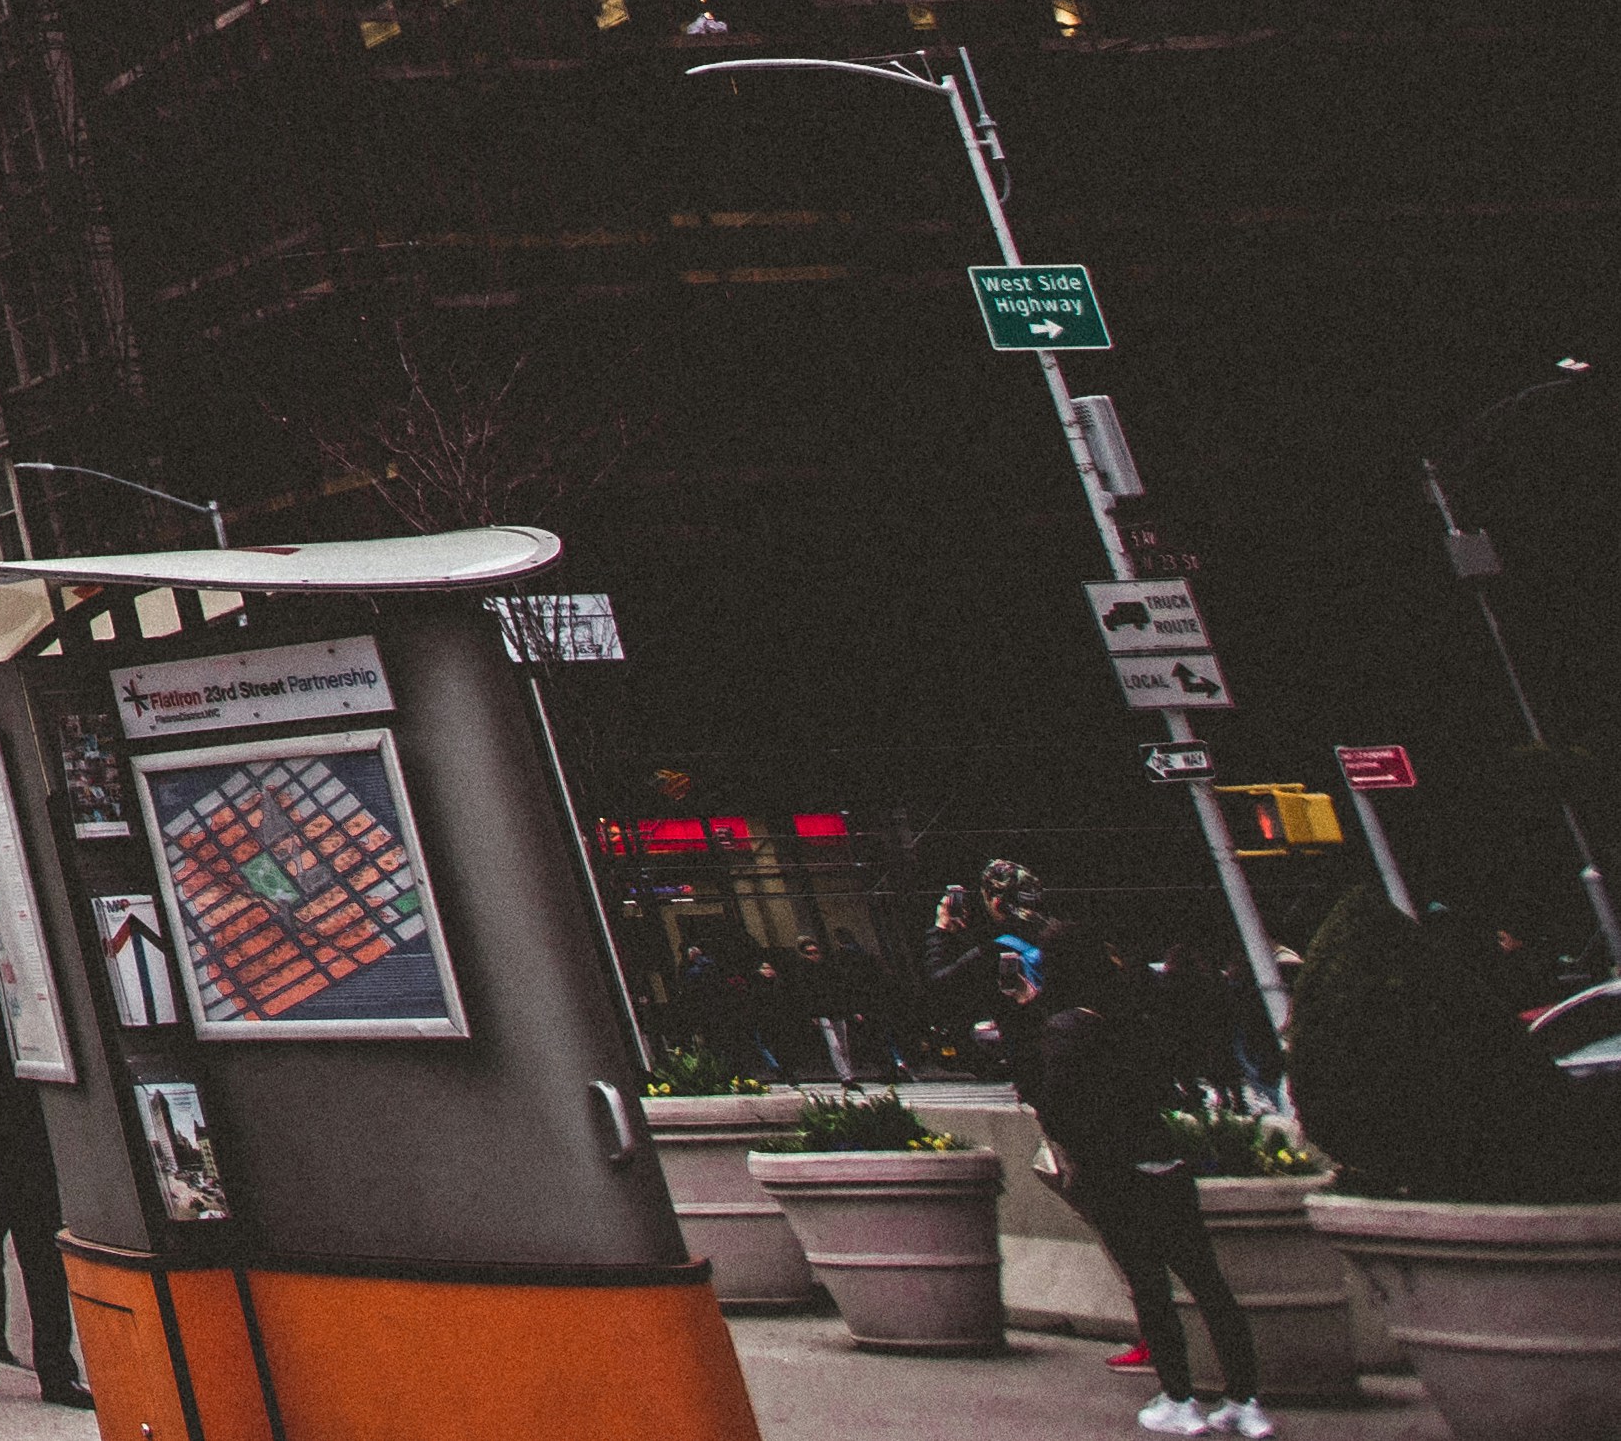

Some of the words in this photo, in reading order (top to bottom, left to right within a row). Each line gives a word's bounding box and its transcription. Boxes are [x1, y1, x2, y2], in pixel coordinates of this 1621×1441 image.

[980, 276, 1033, 292] West
[1037, 274, 1083, 292] Side
[994, 296, 1084, 318] Highway
[1158, 554, 1178, 571] 23
[1144, 595, 1191, 610] TRUCK
[1153, 619, 1201, 634] ROUTE
[204, 682, 237, 703] 23rd
[239, 677, 287, 699] Street
[287, 668, 379, 694] Partnership
[1122, 674, 1171, 690] LOCAL
[1181, 752, 1204, 767] WAY
